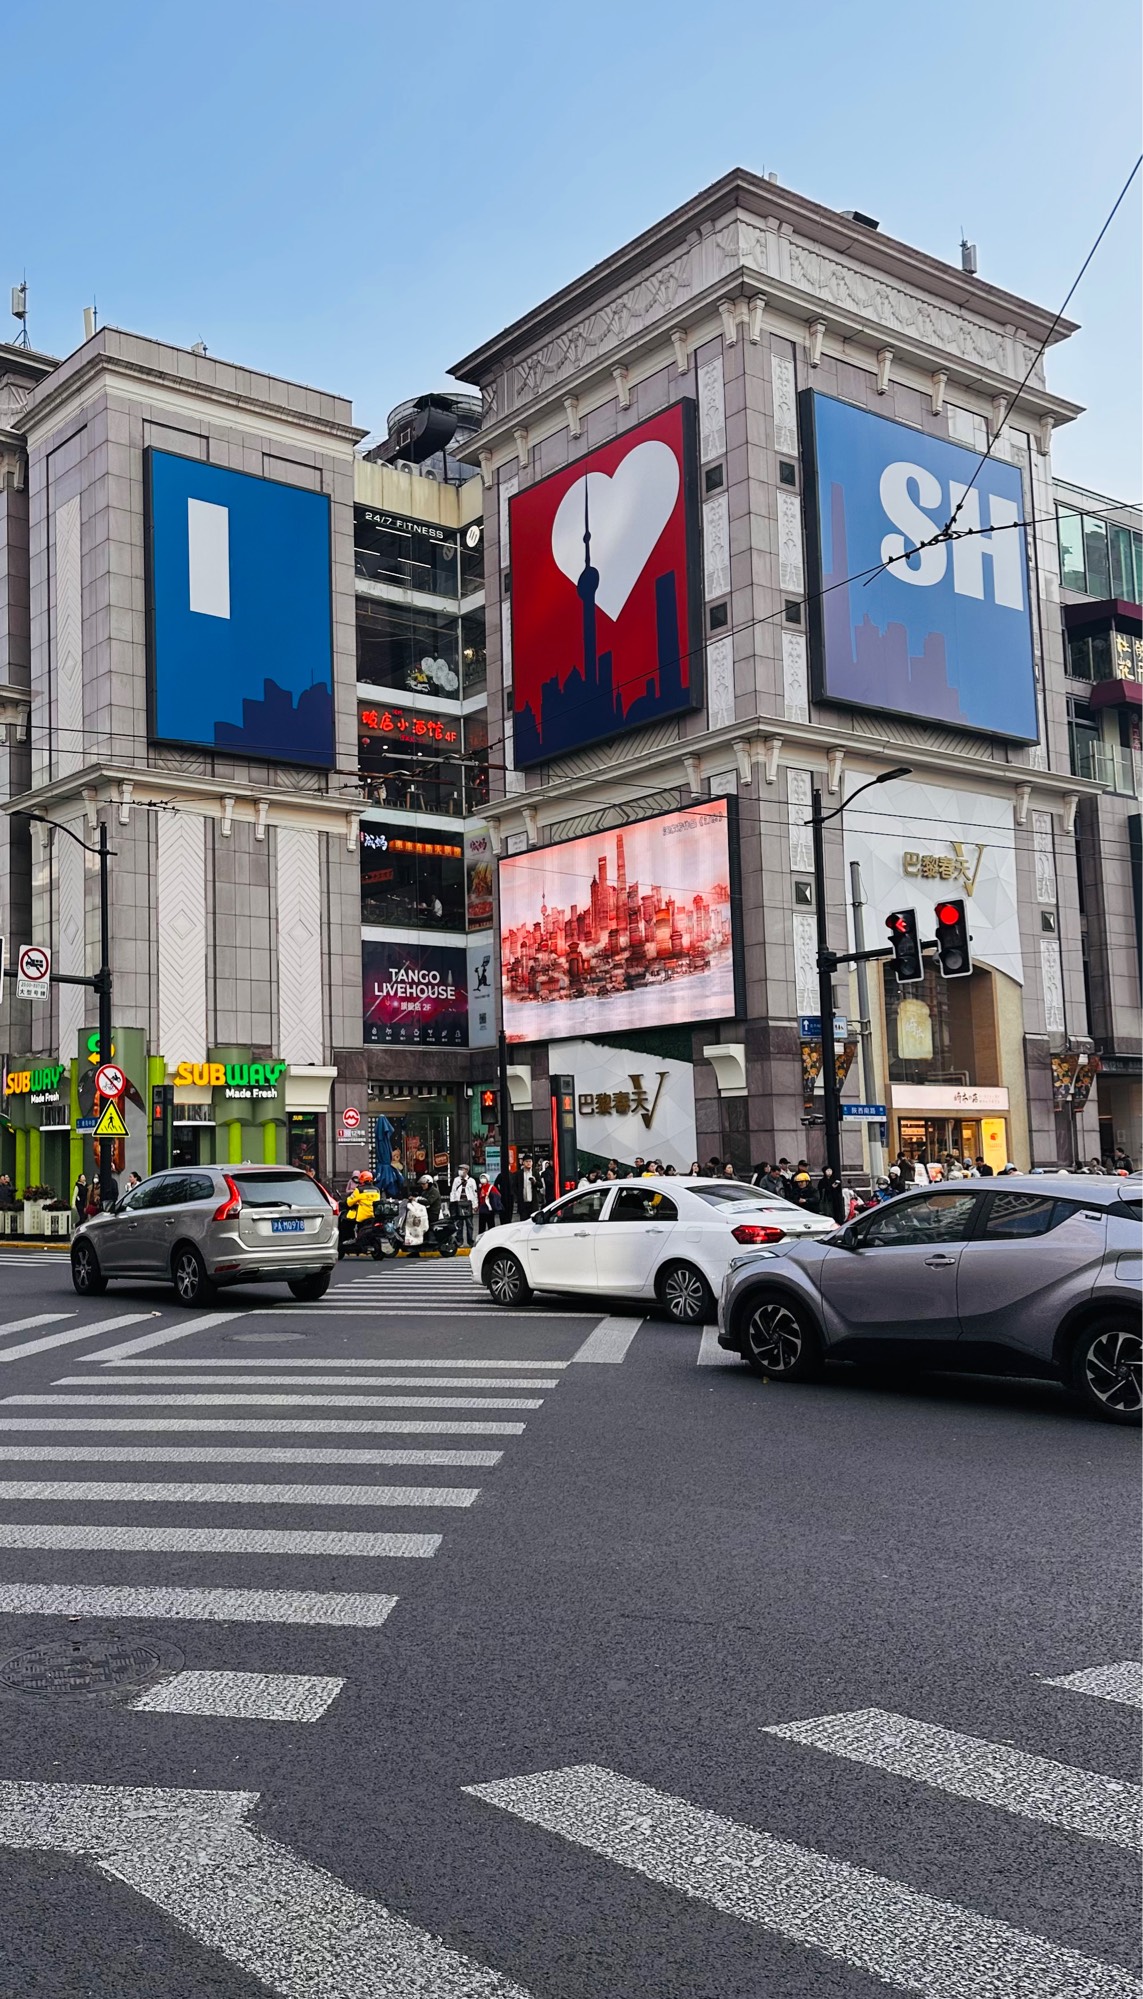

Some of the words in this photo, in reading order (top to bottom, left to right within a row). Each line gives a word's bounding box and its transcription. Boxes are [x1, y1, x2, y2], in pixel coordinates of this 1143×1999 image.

[364, 511, 393, 525] 24/7
[396, 519, 445, 540] FITNESS
[879, 461, 1024, 612] SH
[445, 731, 457, 743] 4F
[903, 851, 971, 881] 巴黎春天
[388, 967, 441, 984] TANGO
[374, 982, 456, 1000] LIVEHOUSE
[422, 1003, 432, 1011] 2F
[4, 1064, 65, 1097] SUBWAY
[173, 1062, 287, 1087] SUBWAY
[30, 1094, 45, 1104] Made
[45, 1092, 60, 1102] Fresh
[225, 1088, 251, 1098] Made
[252, 1088, 278, 1099] Fresh
[578, 1091, 650, 1116] 巴黎春天
